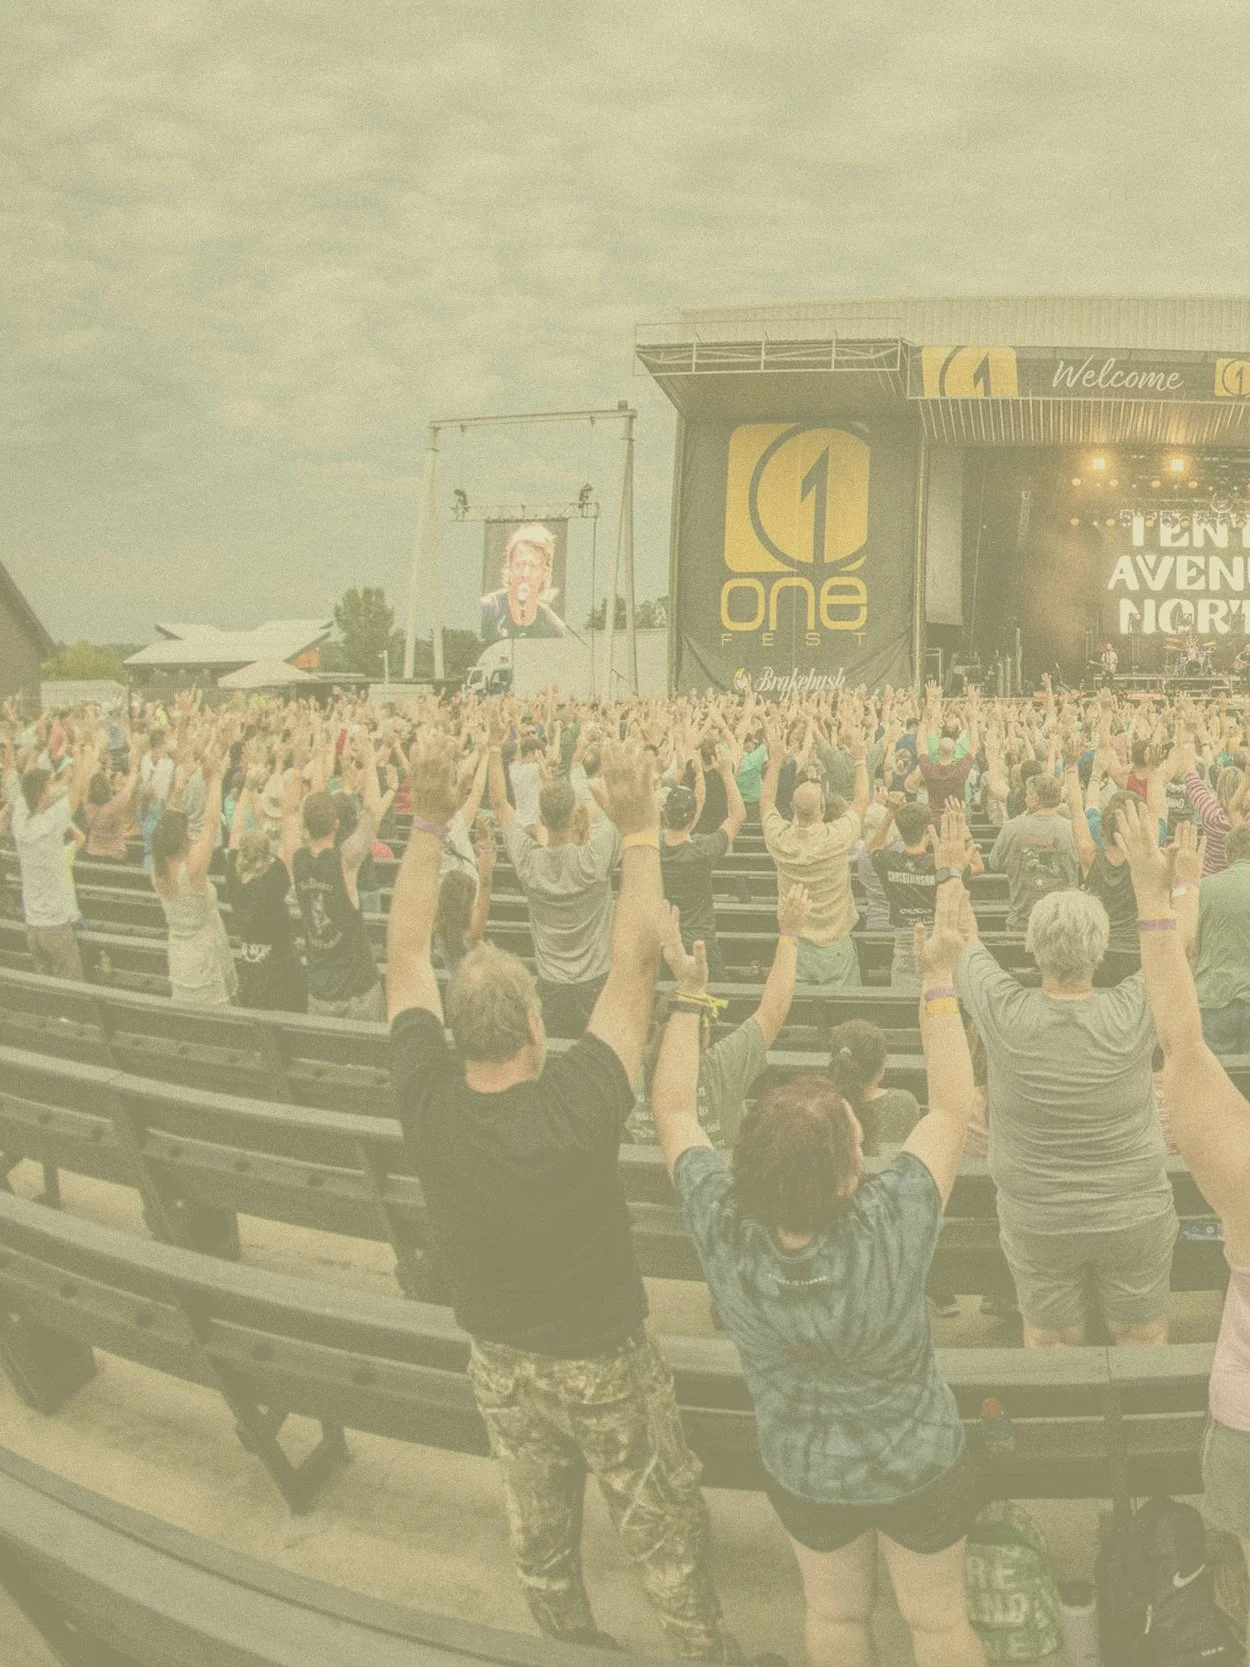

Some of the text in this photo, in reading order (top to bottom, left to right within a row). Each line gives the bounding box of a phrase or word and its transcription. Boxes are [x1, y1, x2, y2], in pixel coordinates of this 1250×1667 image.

[1052, 354, 1185, 392] Welcome
[720, 576, 868, 632] one
[721, 632, 867, 647] FEST
